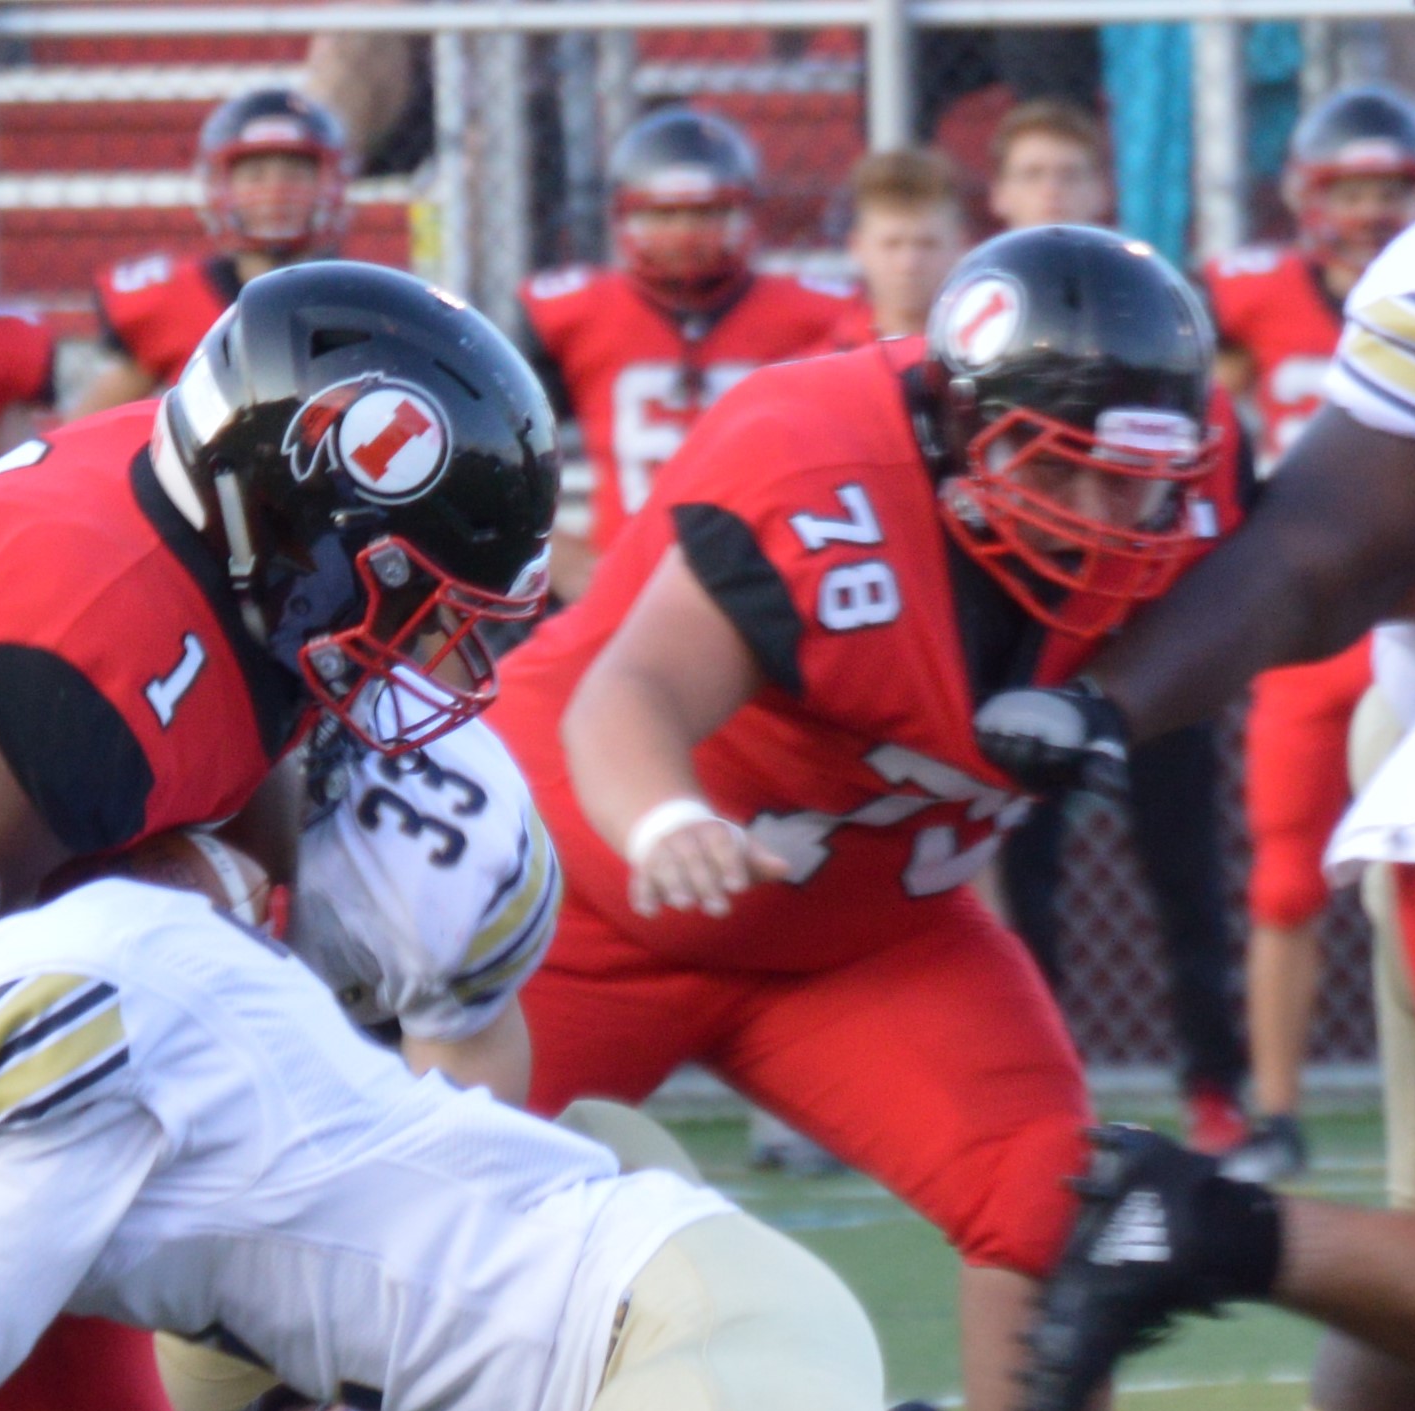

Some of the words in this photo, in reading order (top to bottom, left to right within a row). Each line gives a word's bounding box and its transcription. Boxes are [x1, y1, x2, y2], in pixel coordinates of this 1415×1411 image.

[787, 479, 902, 633] 78
[142, 630, 207, 729] 1
[356, 748, 489, 871] 33
